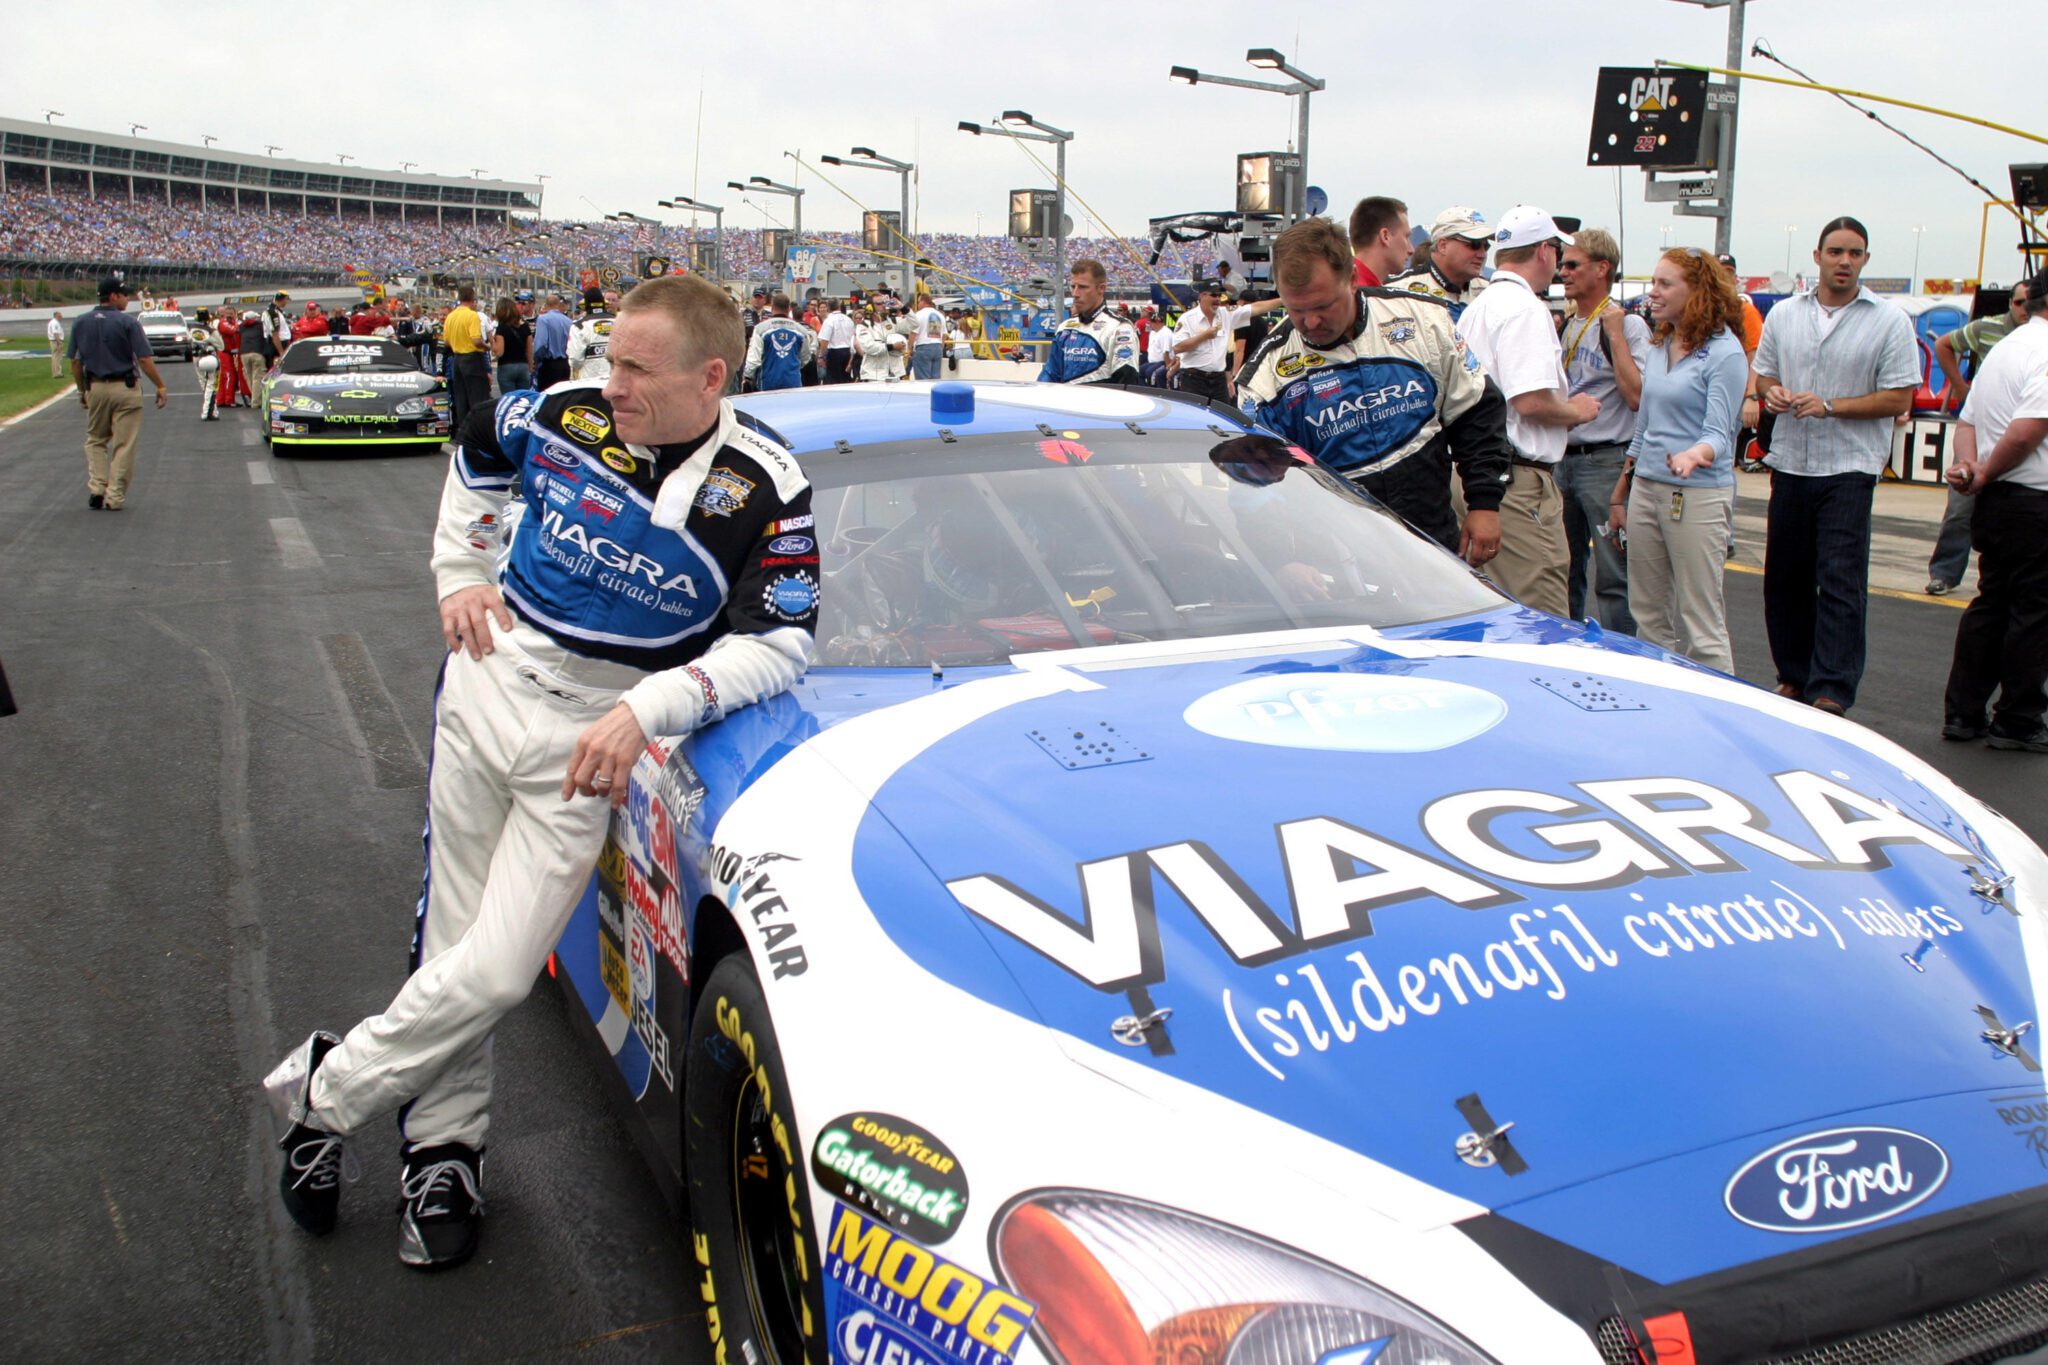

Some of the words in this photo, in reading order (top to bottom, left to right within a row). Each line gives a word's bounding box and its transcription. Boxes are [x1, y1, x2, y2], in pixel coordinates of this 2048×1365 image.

[1630, 76, 1675, 111] CAT
[1633, 135, 1657, 152] 22
[1679, 187, 1713, 197] musco
[317, 344, 382, 354] GMAC
[328, 355, 371, 367] ditech.com
[293, 373, 417, 389] ditech.com
[1313, 379, 1341, 393] ROUSH
[324, 415, 360, 424] MONTE
[362, 415, 399, 424] CARLO
[1304, 379, 1425, 428] VIAGRA
[569, 415, 602, 435] NEXTEL
[546, 445, 574, 465] Ford
[741, 432, 790, 472] VIAGRA
[548, 478, 577, 501] MAXWELL
[583, 486, 625, 513] ROUSH
[779, 514, 814, 532] NASCAR
[543, 501, 699, 600] VIAGRA
[778, 538, 807, 551] Ford
[660, 600, 694, 617] tablets
[777, 589, 810, 599] VIAGRA
[1241, 687, 1447, 737] Pfizer
[651, 796, 679, 893] 3M
[945, 769, 1981, 990] VIAGRA
[626, 859, 660, 946] Holley
[660, 885, 687, 960] MAC
[631, 927, 649, 977] EA
[661, 930, 688, 982] TOOLS
[1222, 904, 1619, 1081] (sildenafil
[1623, 879, 1847, 958] citrate)
[1842, 898, 1965, 943] tablets
[631, 997, 674, 1093] JESEL
[852, 1115, 955, 1175] GOODYEAR
[815, 1127, 964, 1229] Gatorback
[1775, 1138, 1913, 1221] Ford
[845, 1182, 909, 1226] BELTS
[828, 1208, 1037, 1355] MOOG
[832, 1258, 918, 1327] CHASSIS
